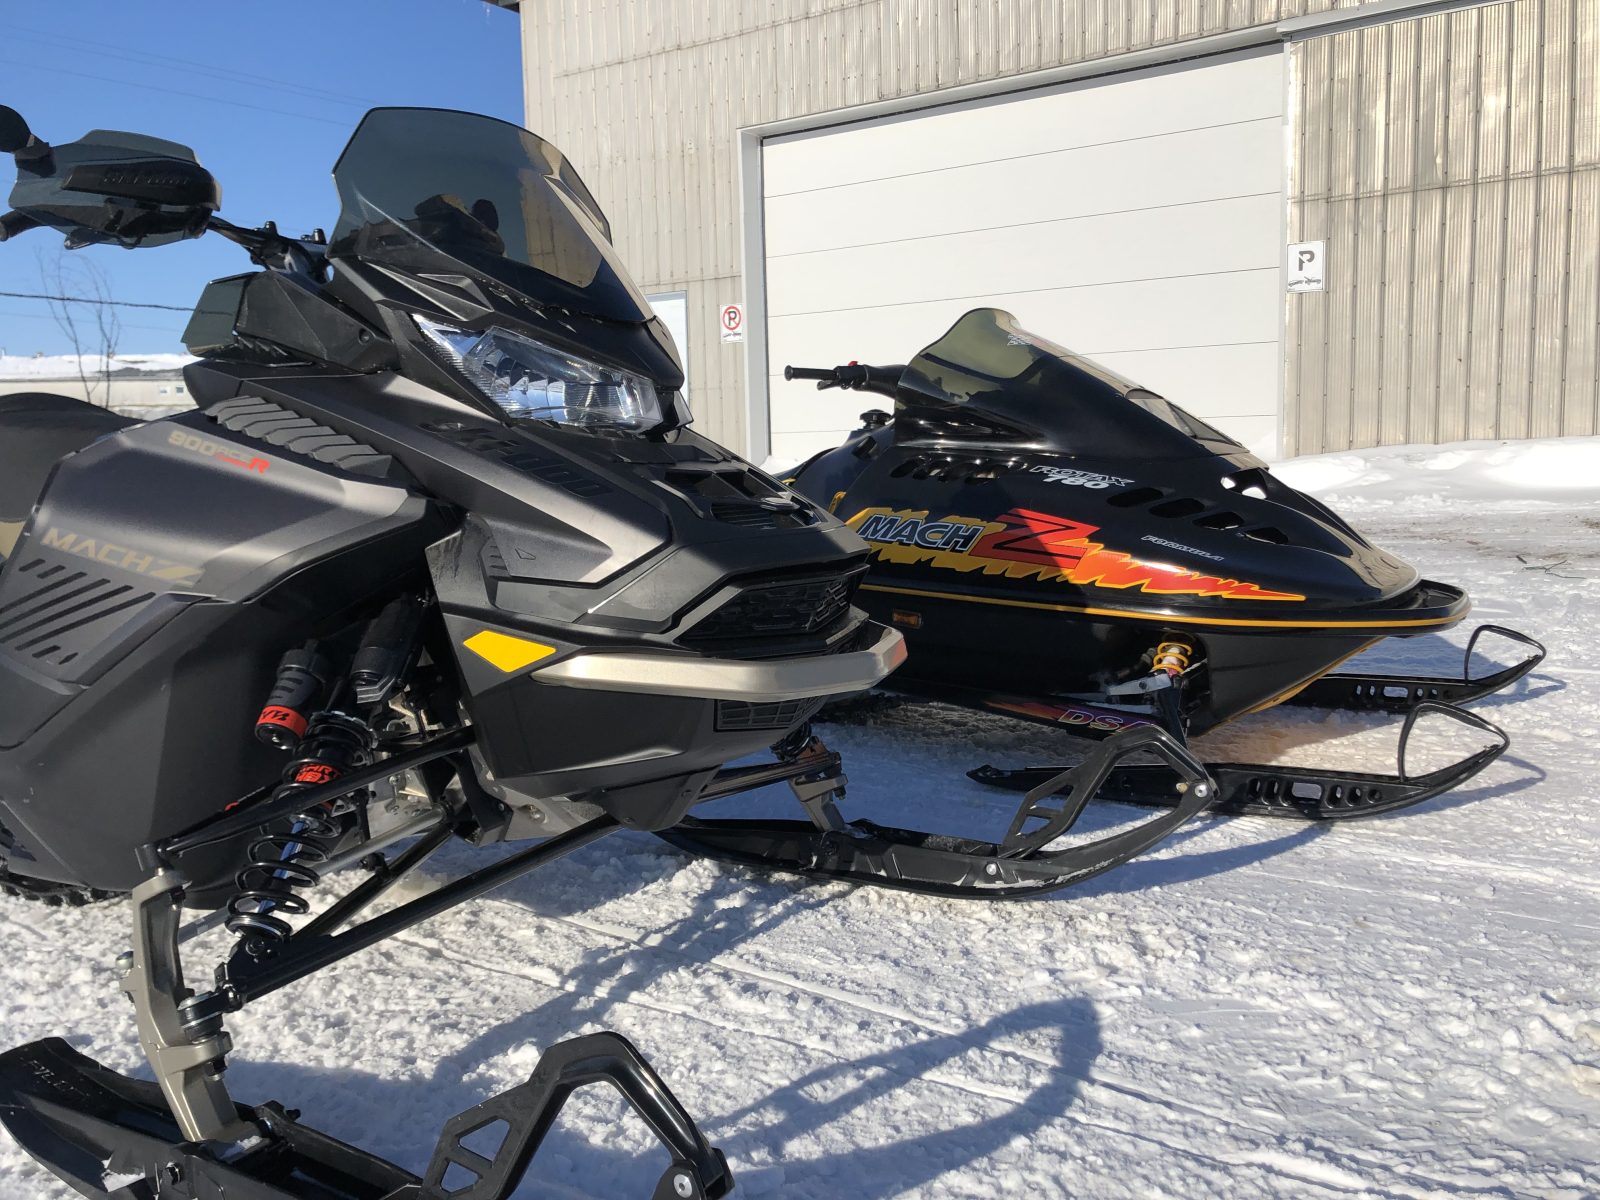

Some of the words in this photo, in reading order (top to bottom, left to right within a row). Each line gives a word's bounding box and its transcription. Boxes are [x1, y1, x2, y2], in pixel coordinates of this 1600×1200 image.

[1298, 250, 1315, 271] P
[728, 310, 737, 327] P
[1029, 465, 1135, 487] ROTAX
[859, 514, 984, 551] MACH
[968, 508, 1100, 569] Z
[41, 528, 153, 573] MACH
